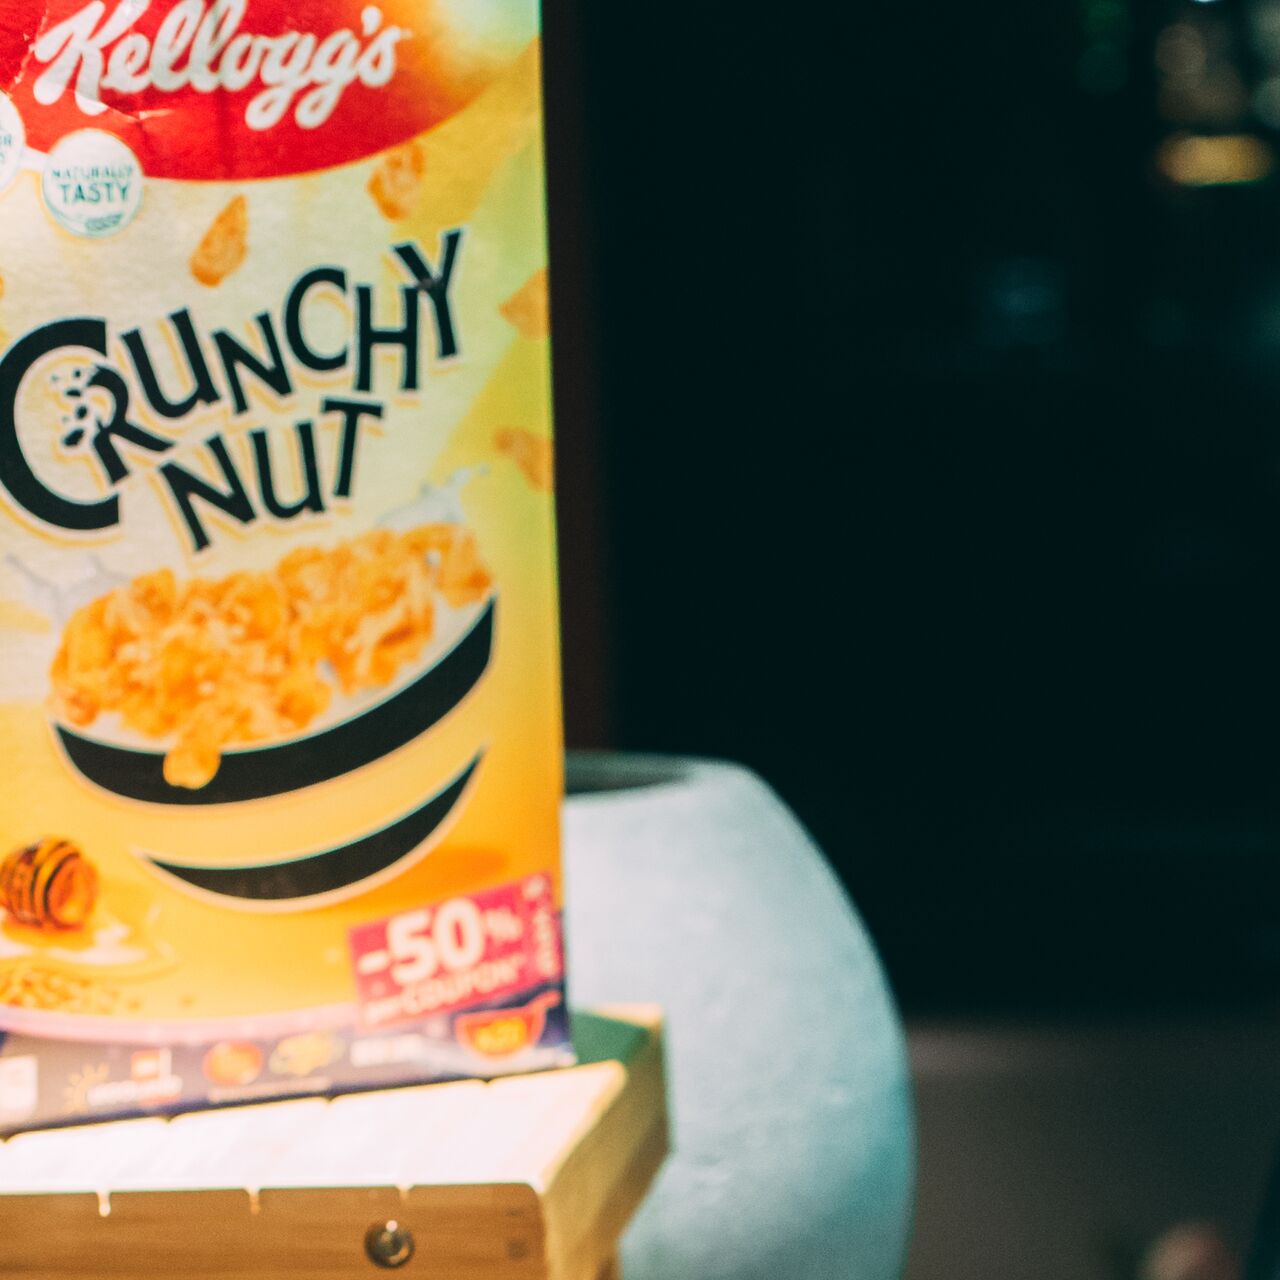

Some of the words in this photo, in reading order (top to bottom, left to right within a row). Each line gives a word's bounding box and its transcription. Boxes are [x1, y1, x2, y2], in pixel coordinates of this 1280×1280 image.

[33, 0, 411, 130] Kellogg's
[58, 181, 131, 204] TASTY
[0, 227, 463, 531] CRUNCHY
[158, 395, 384, 553] NUT
